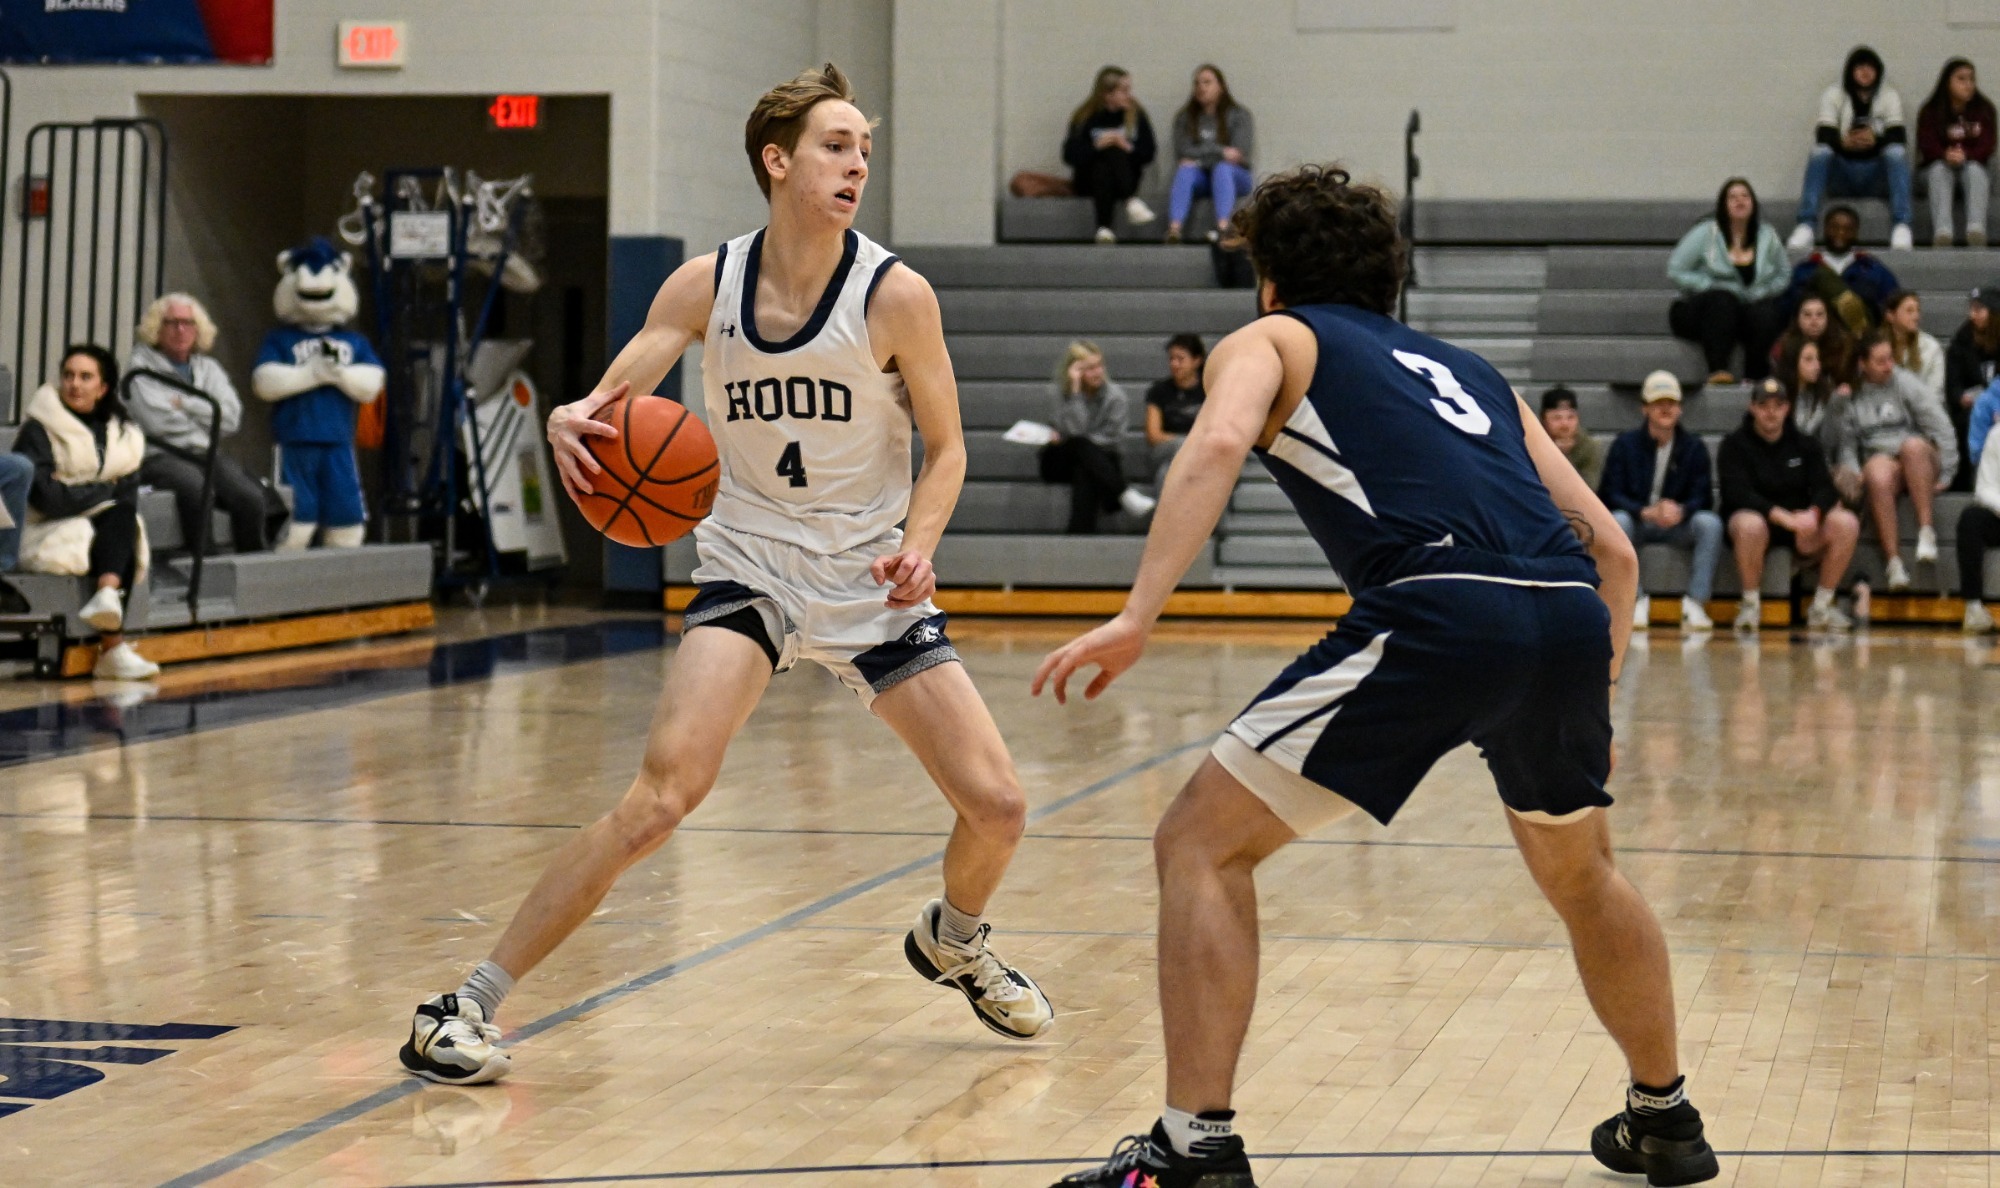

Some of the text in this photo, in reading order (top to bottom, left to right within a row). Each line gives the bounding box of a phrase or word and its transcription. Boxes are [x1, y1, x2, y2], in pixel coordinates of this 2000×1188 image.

[350, 27, 394, 60] EXIT
[497, 95, 538, 127] EXIT
[724, 376, 852, 422] HOOD
[1392, 348, 1492, 435] 3
[775, 441, 808, 488] 4
